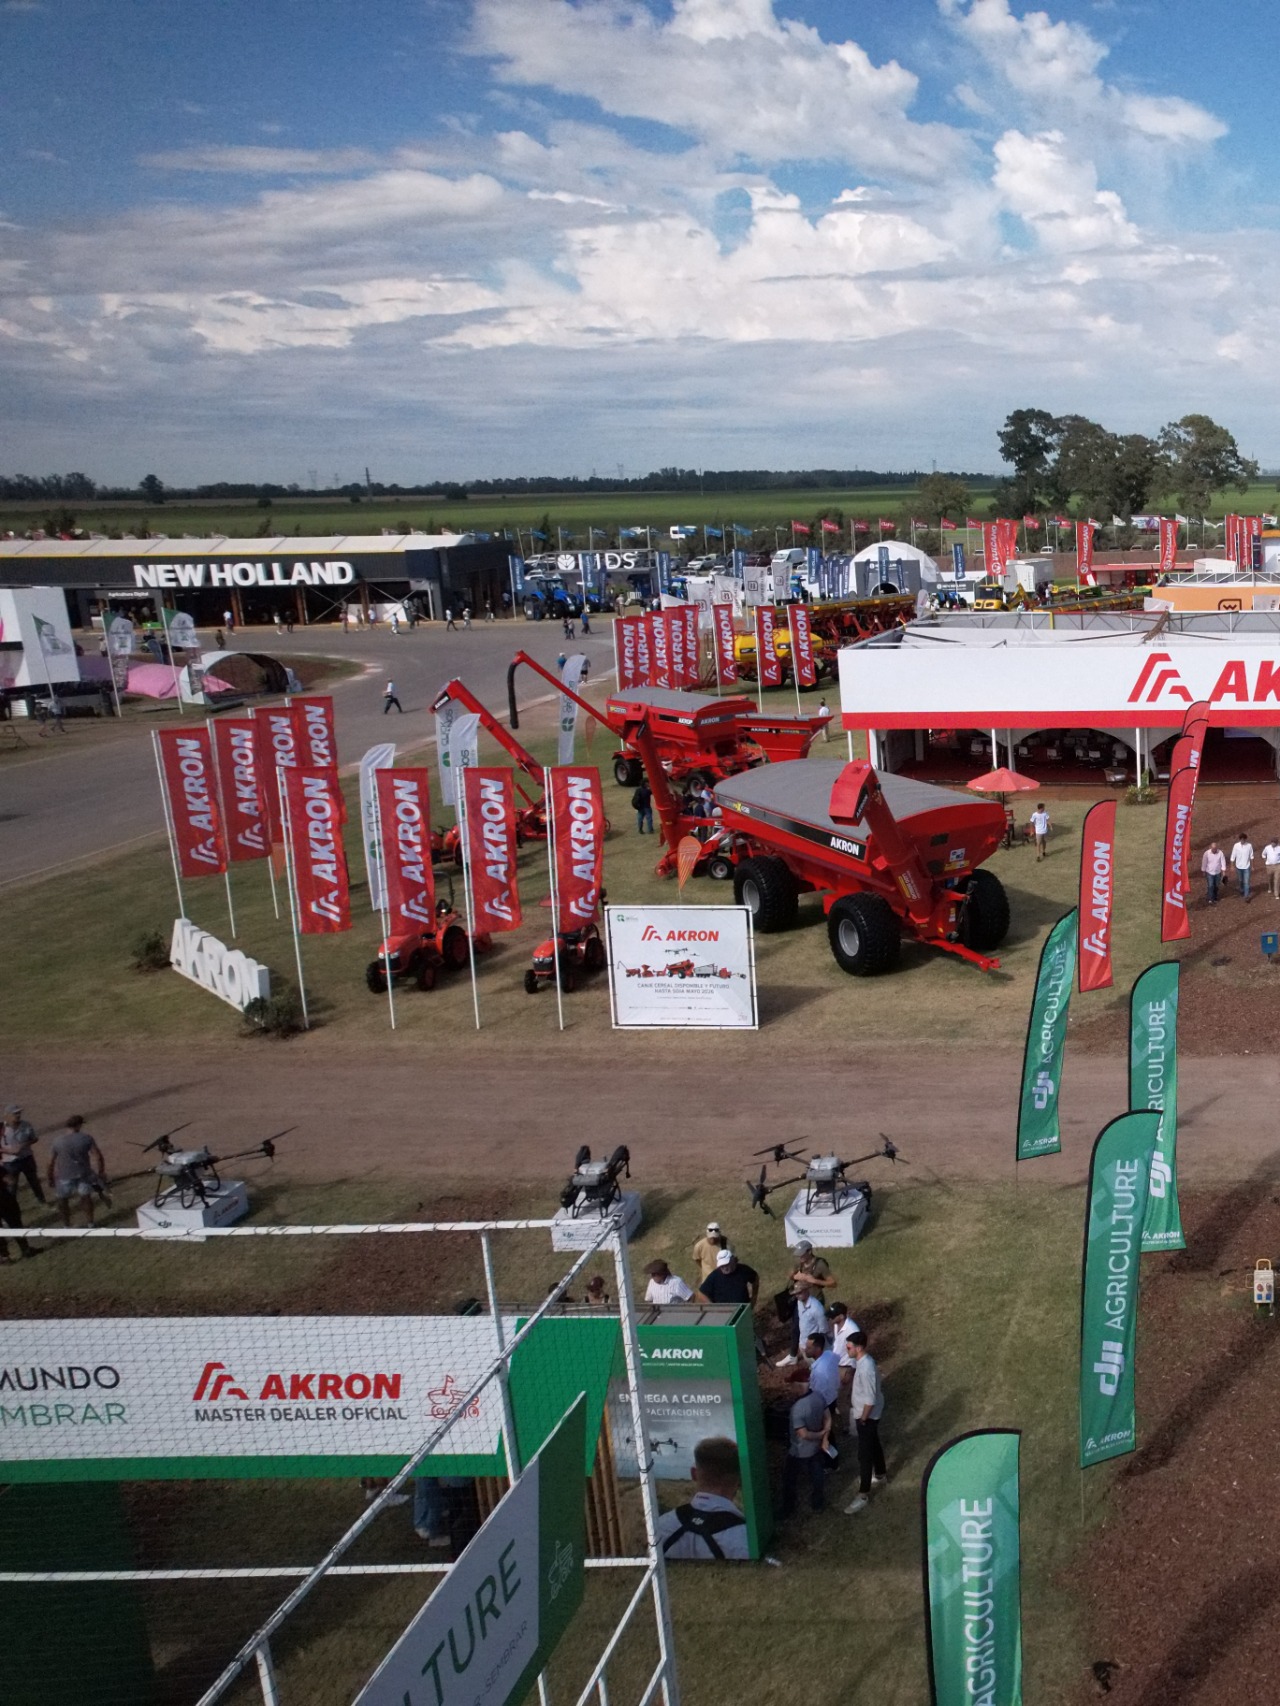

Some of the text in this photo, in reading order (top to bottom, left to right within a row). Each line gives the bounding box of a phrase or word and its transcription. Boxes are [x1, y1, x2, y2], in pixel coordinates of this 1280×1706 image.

[133, 562, 355, 588] NEW HOLLAND
[623, 624, 635, 679] AKRON
[652, 616, 668, 669] AKRON
[672, 619, 684, 674] AKRON
[685, 610, 698, 661] AKRON
[720, 609, 734, 661] AKRON
[762, 611, 777, 662] AKRON
[795, 609, 810, 661] AKRON
[269, 715, 298, 768] RON
[304, 704, 329, 767] KRON
[176, 738, 214, 832] AKRON
[229, 727, 260, 818] AKRON
[302, 777, 338, 884] AKRON
[393, 778, 426, 884] AKRON
[480, 777, 509, 884] AKRON
[567, 776, 596, 883] AKRON
[830, 836, 860, 856] AKRON
[1172, 804, 1189, 876] AKRON
[1091, 841, 1111, 923] AKRON
[666, 930, 719, 942] AKRON
[170, 918, 270, 1012] AKRON
[1041, 939, 1068, 1064] AGRICULTURE
[1147, 999, 1166, 1142] ARICULTURE
[1033, 1136, 1058, 1147] AKRON
[1104, 1157, 1139, 1330] AGRICULTURE
[1152, 1230, 1180, 1239] AKRON
[651, 1348, 704, 1360] AKRON
[259, 1372, 402, 1401] AKRON
[646, 1408, 712, 1417] ACITACIONES
[671, 1394, 680, 1404] A
[681, 1394, 721, 1404] CAMPO
[0, 1402, 129, 1430] MBRAR
[194, 1406, 408, 1422] MASTER DEALER OFICIAL
